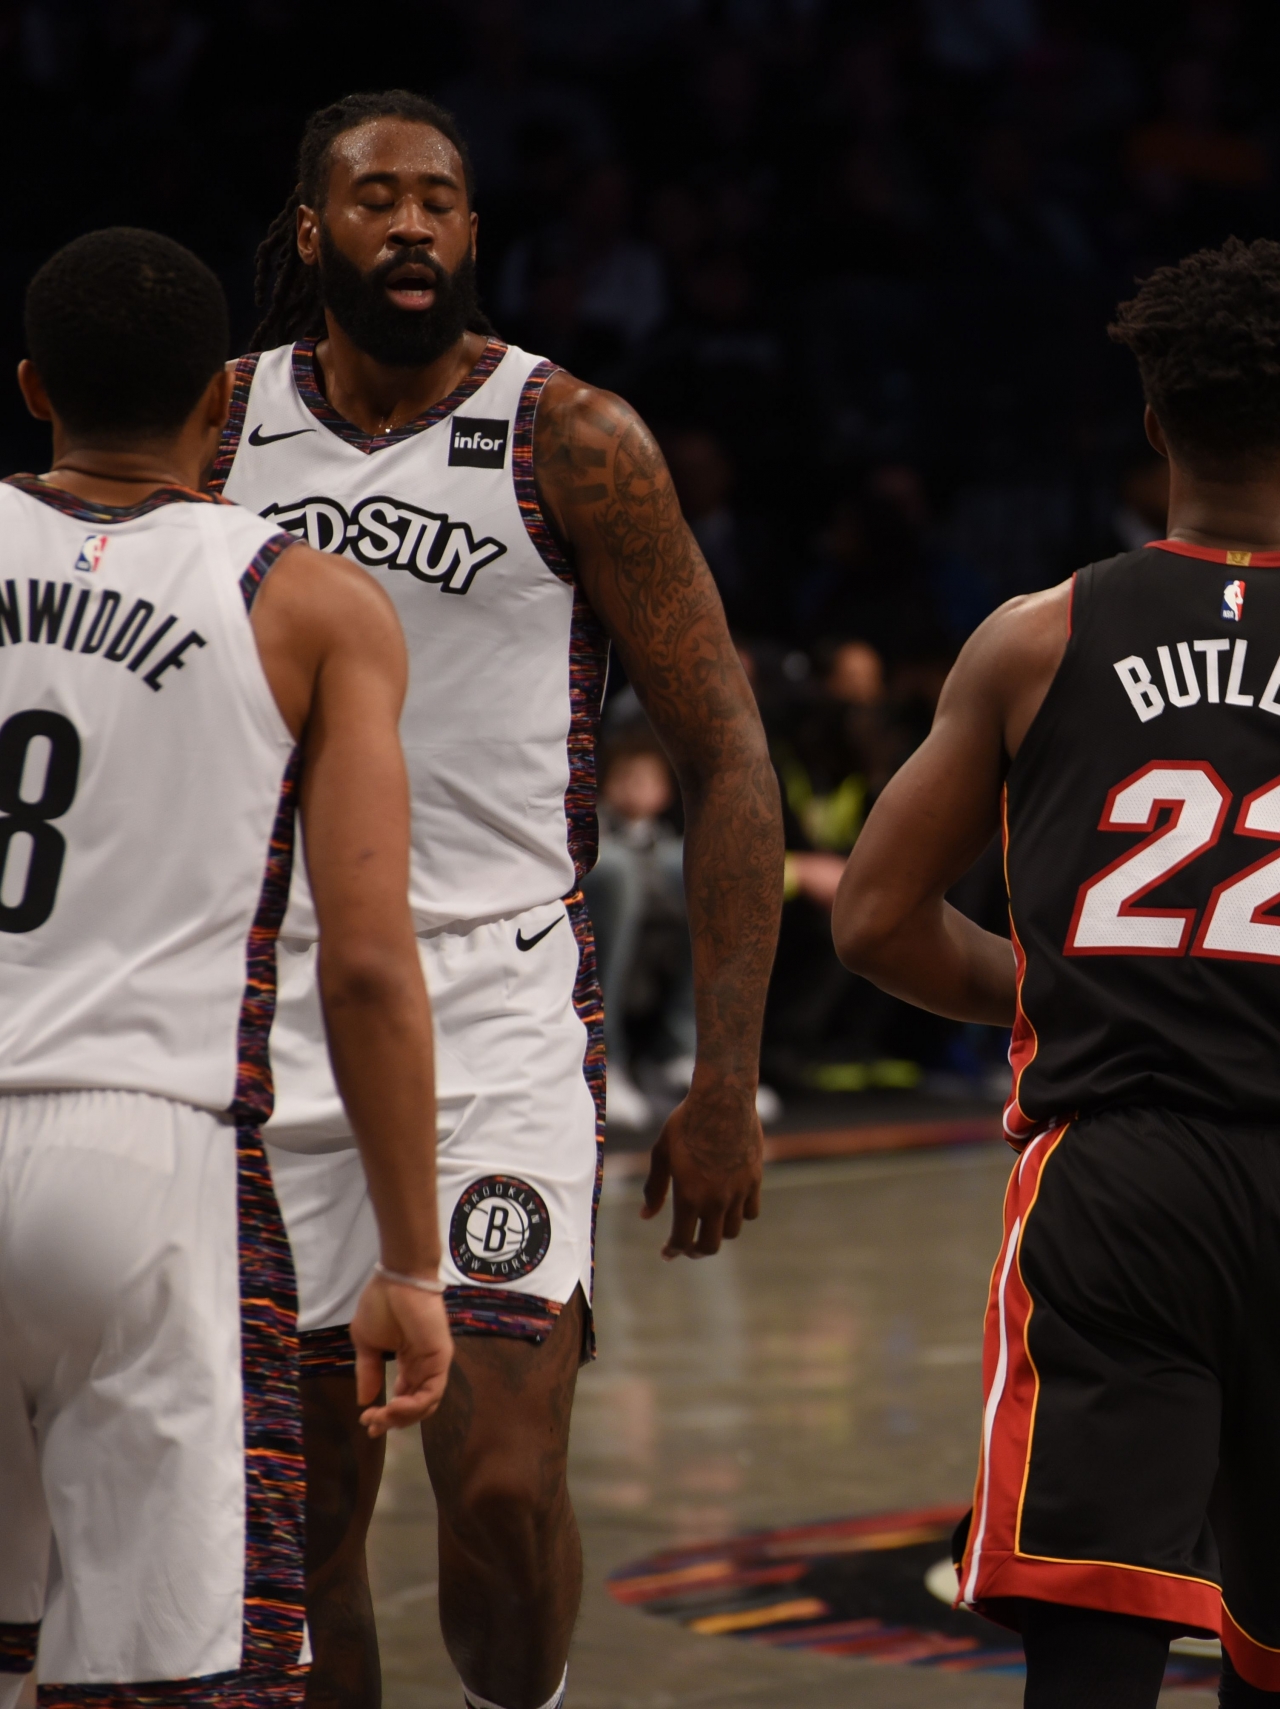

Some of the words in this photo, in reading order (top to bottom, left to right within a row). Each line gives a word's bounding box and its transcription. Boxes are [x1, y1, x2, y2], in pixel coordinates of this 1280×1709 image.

[453, 431, 504, 452] infor
[0, 708, 82, 934] 8
[462, 1183, 541, 1225] BROOKLYN
[483, 1205, 509, 1252] B
[458, 1242, 482, 1272] NEW
[490, 1250, 531, 1275] YORK
